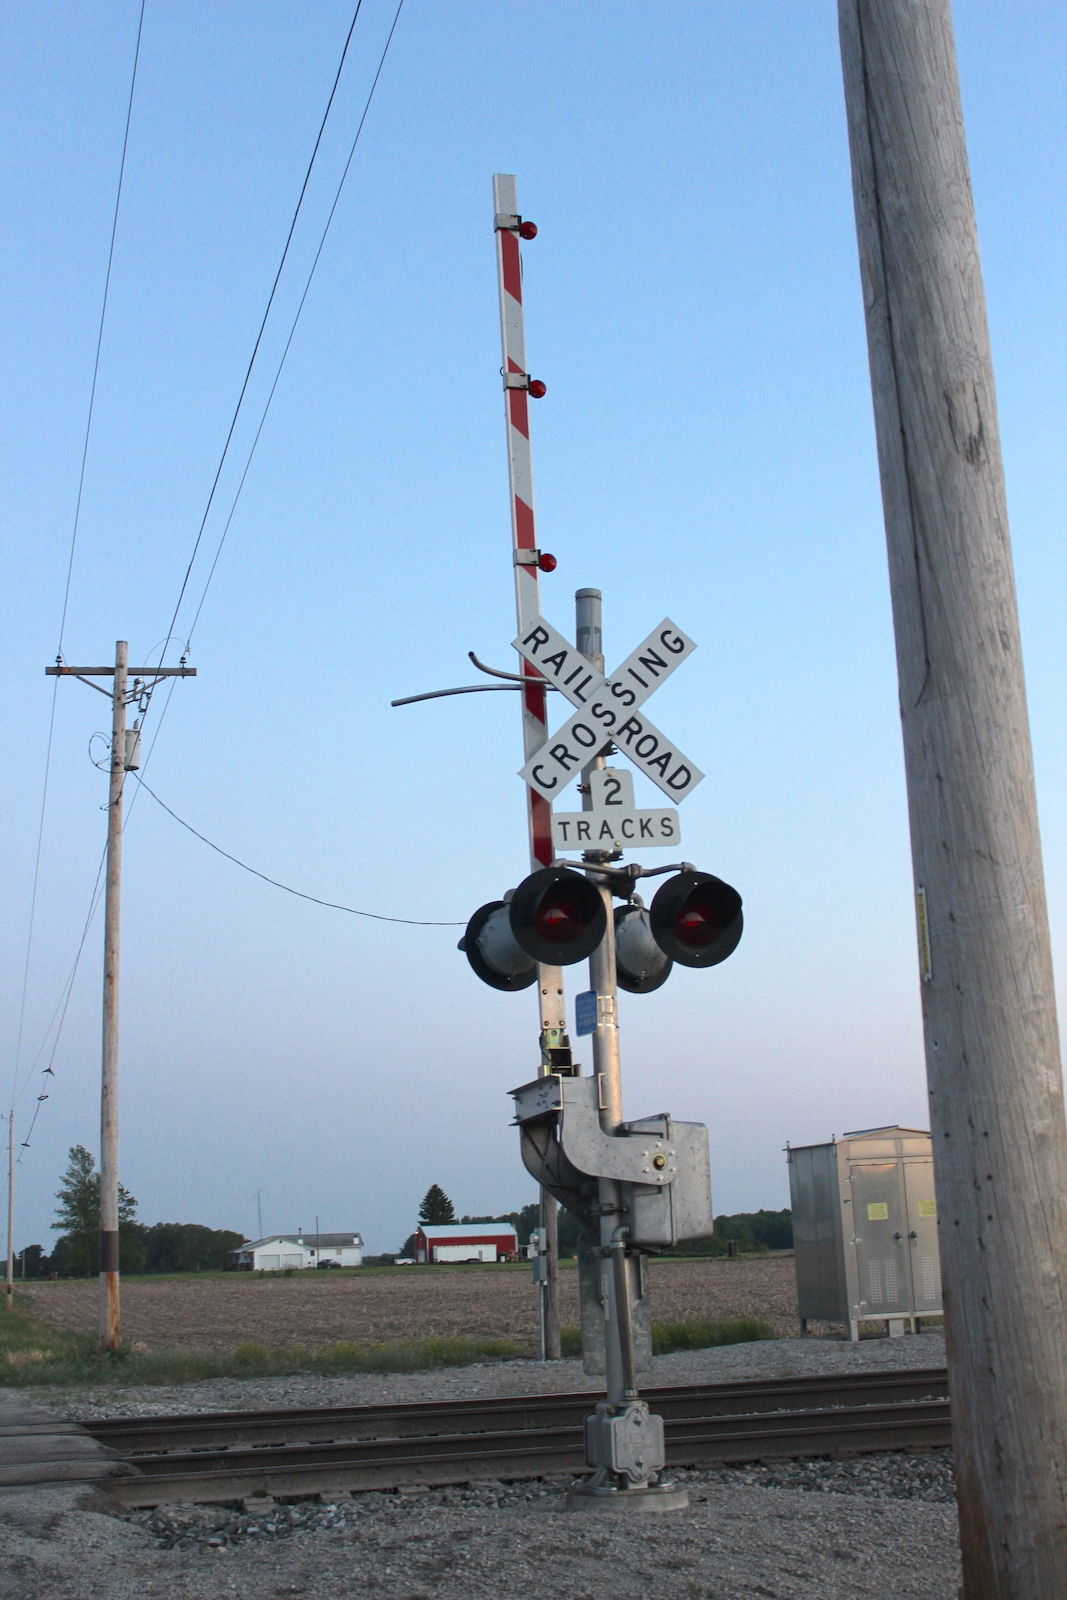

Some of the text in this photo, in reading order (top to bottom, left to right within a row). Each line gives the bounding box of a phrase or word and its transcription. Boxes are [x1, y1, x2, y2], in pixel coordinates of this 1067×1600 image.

[522, 625, 692, 790] RAIL ROAD
[532, 630, 685, 789] CROSSING
[558, 817, 674, 841] TRACKS
[603, 778, 623, 805] 2
